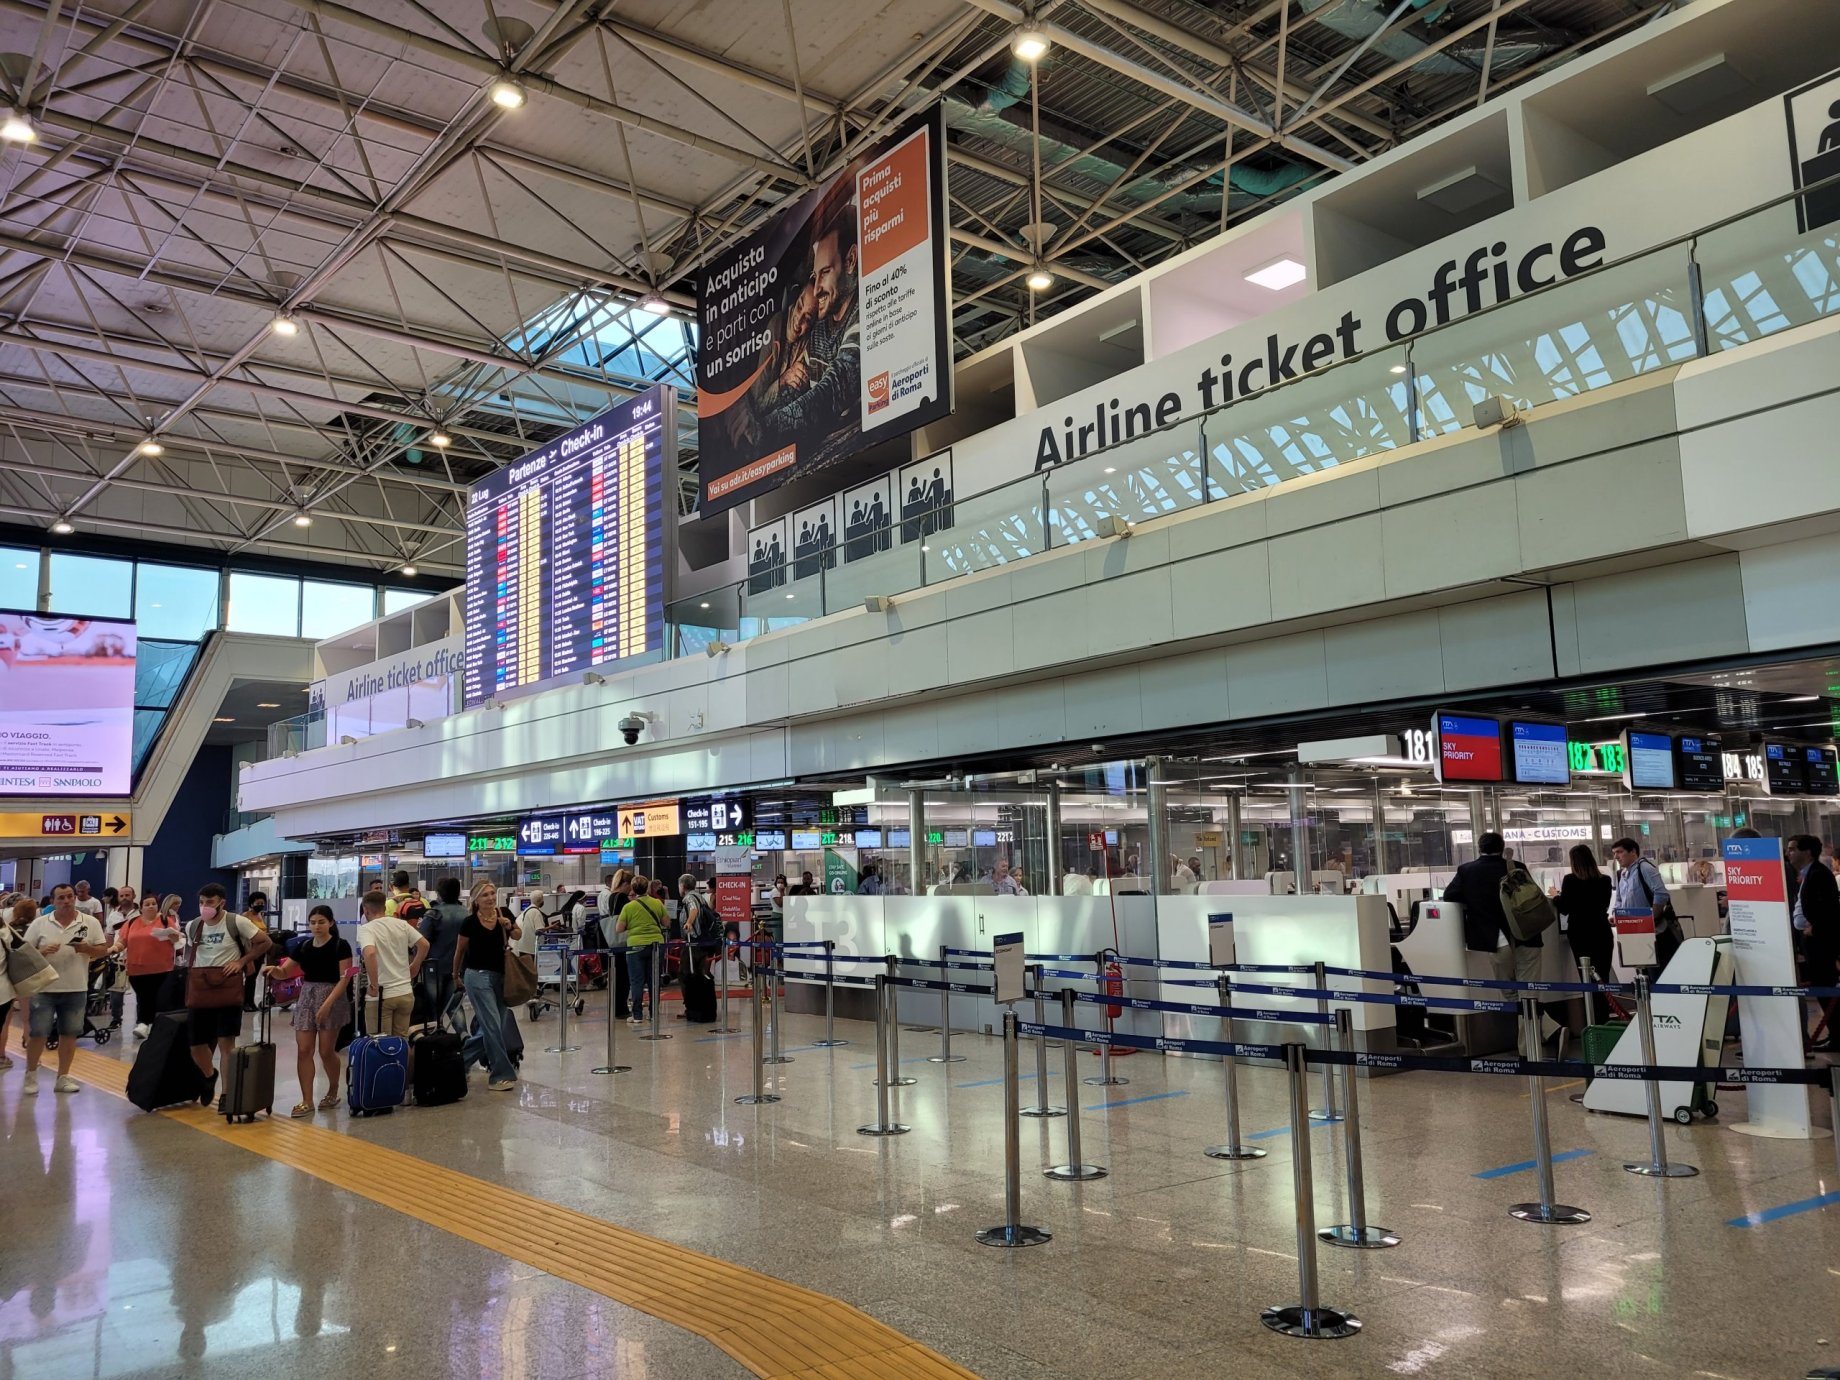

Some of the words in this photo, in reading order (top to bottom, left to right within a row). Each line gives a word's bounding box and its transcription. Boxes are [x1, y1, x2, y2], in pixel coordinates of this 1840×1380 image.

[863, 165, 890, 191] Prima
[864, 172, 901, 208] acquisti
[864, 208, 878, 230] più
[865, 208, 903, 245] risparmi
[706, 246, 764, 298] Acquista
[866, 282, 880, 296] Fino
[882, 274, 888, 286] al
[891, 264, 907, 281] 40%
[706, 304, 718, 324] in
[721, 266, 778, 314] anticipo
[866, 297, 872, 309] di
[874, 286, 898, 305] sconto
[866, 305, 886, 320] rispetto
[706, 335, 714, 350] e
[717, 309, 746, 351] parti
[750, 298, 774, 324] con
[707, 357, 722, 378] un
[726, 329, 771, 367] sorriso
[1034, 397, 1182, 474] Airline
[1197, 310, 1364, 417] ticket
[1386, 226, 1606, 342] office
[869, 376, 887, 392] easy
[892, 364, 928, 390] Aeroporti
[892, 390, 899, 401] di
[900, 381, 922, 397] Roma
[632, 400, 652, 419] 19:44
[509, 456, 546, 484] Partenze
[561, 424, 603, 456] Check-in
[709, 485, 720, 494] Vai
[721, 483, 729, 491] su
[730, 451, 794, 488] adr.it/easyparking
[479, 489, 489, 501] Lug
[347, 674, 384, 702] Airline
[387, 661, 422, 690] ticket
[426, 648, 464, 677] office
[10, 732, 51, 740] VIAGGIO.
[1404, 729, 1434, 762] 181
[1443, 742, 1456, 750] SKY
[1443, 751, 1473, 760] PRIORITY
[1568, 742, 1593, 770] 182
[1601, 744, 1624, 772] 183
[1722, 753, 1742, 778] 184
[1746, 755, 1764, 779] 185
[53, 778, 102, 787] SANPAOLO
[634, 816, 644, 826] VAT
[687, 809, 708, 818] Check-in
[593, 818, 611, 826] Check-in
[688, 820, 708, 829] 151-195
[719, 835, 733, 845] 215
[737, 835, 752, 846] 216
[822, 833, 835, 844] 217
[839, 834, 852, 844] 218
[1505, 831, 1525, 839] ANA
[1534, 828, 1587, 838] CUSTOMS
[470, 837, 488, 850] 211
[493, 837, 514, 850] 212
[623, 838, 634, 848] 21
[1727, 867, 1742, 875] SKY
[718, 881, 746, 889] CHECK-IN
[1728, 876, 1763, 885] PRIORITY
[805, 911, 859, 972] T3
[1368, 1054, 1402, 1062] Aeroporti
[1484, 1060, 1520, 1068] Aeroporti
